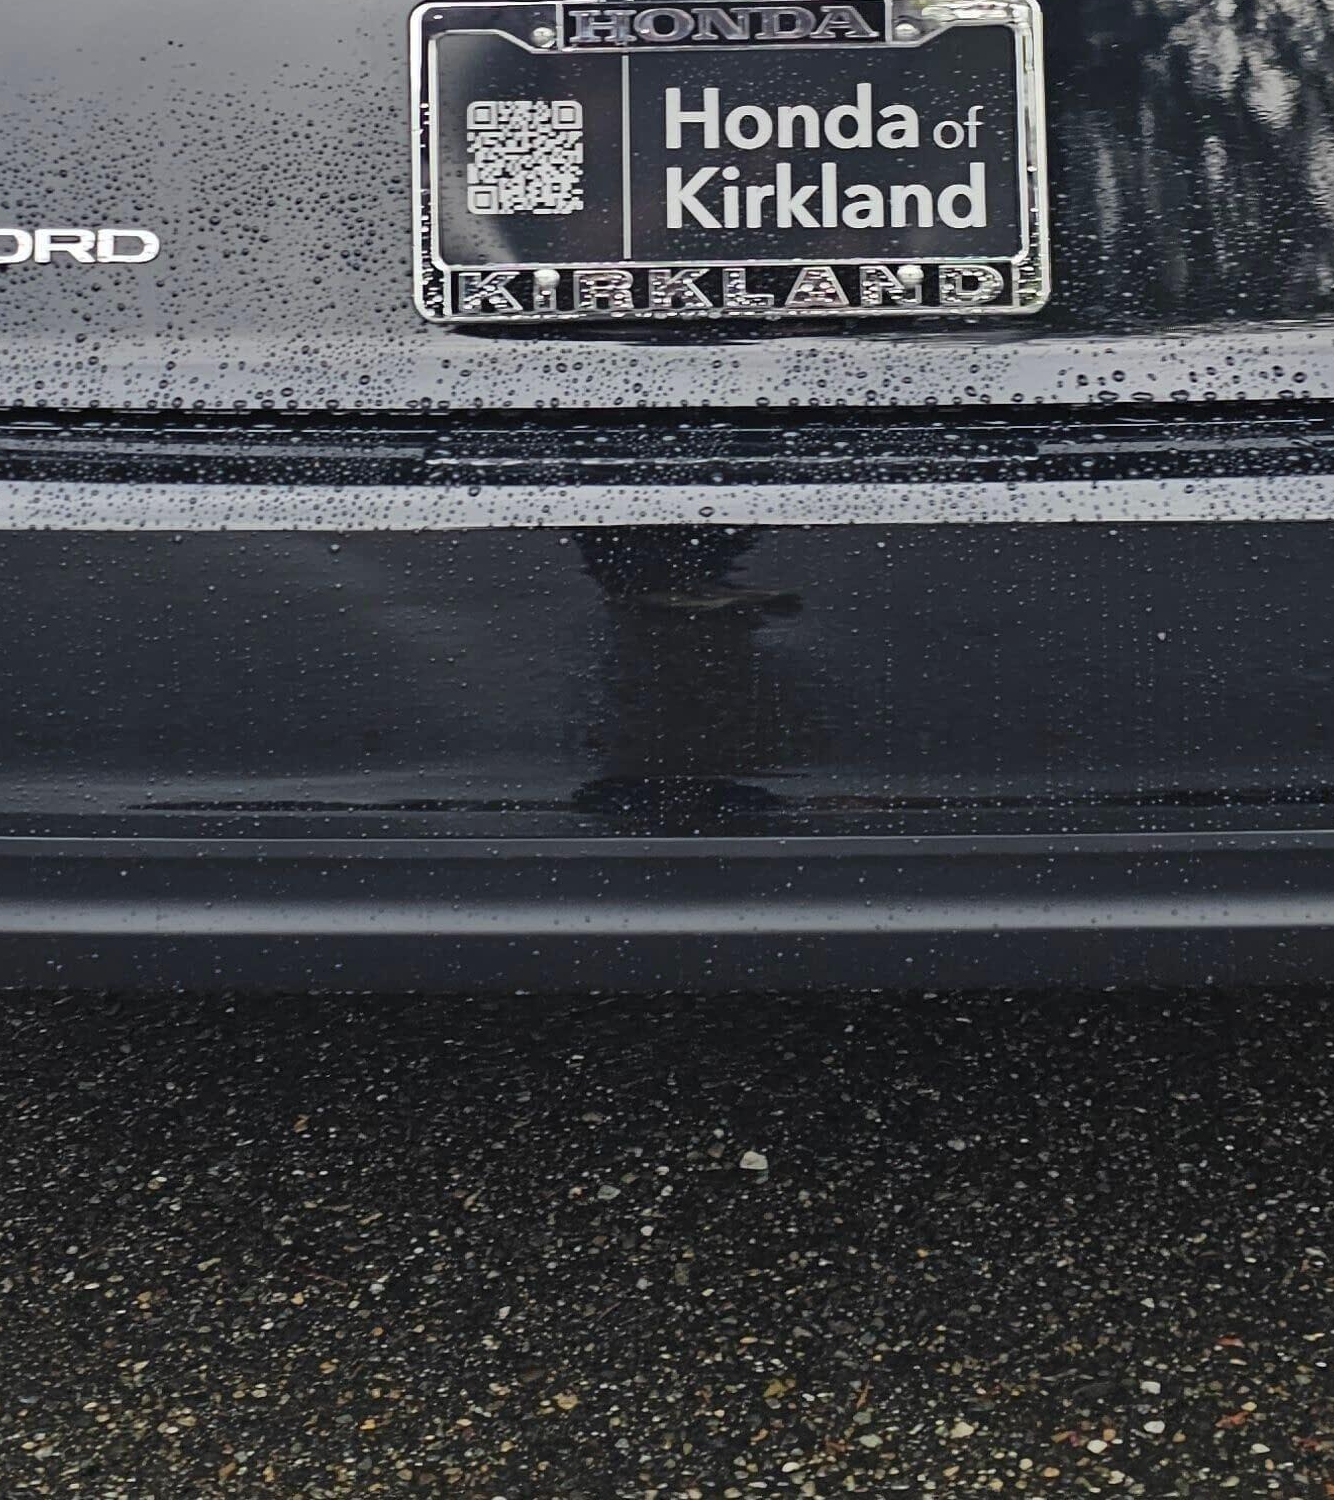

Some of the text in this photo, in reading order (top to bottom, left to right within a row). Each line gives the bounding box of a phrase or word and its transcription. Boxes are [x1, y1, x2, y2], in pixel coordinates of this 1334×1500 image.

[568, 5, 880, 45] HONDA
[665, 83, 984, 149] Honda of
[665, 162, 987, 229] Kirkland
[457, 263, 1005, 313] KIRKLAND
